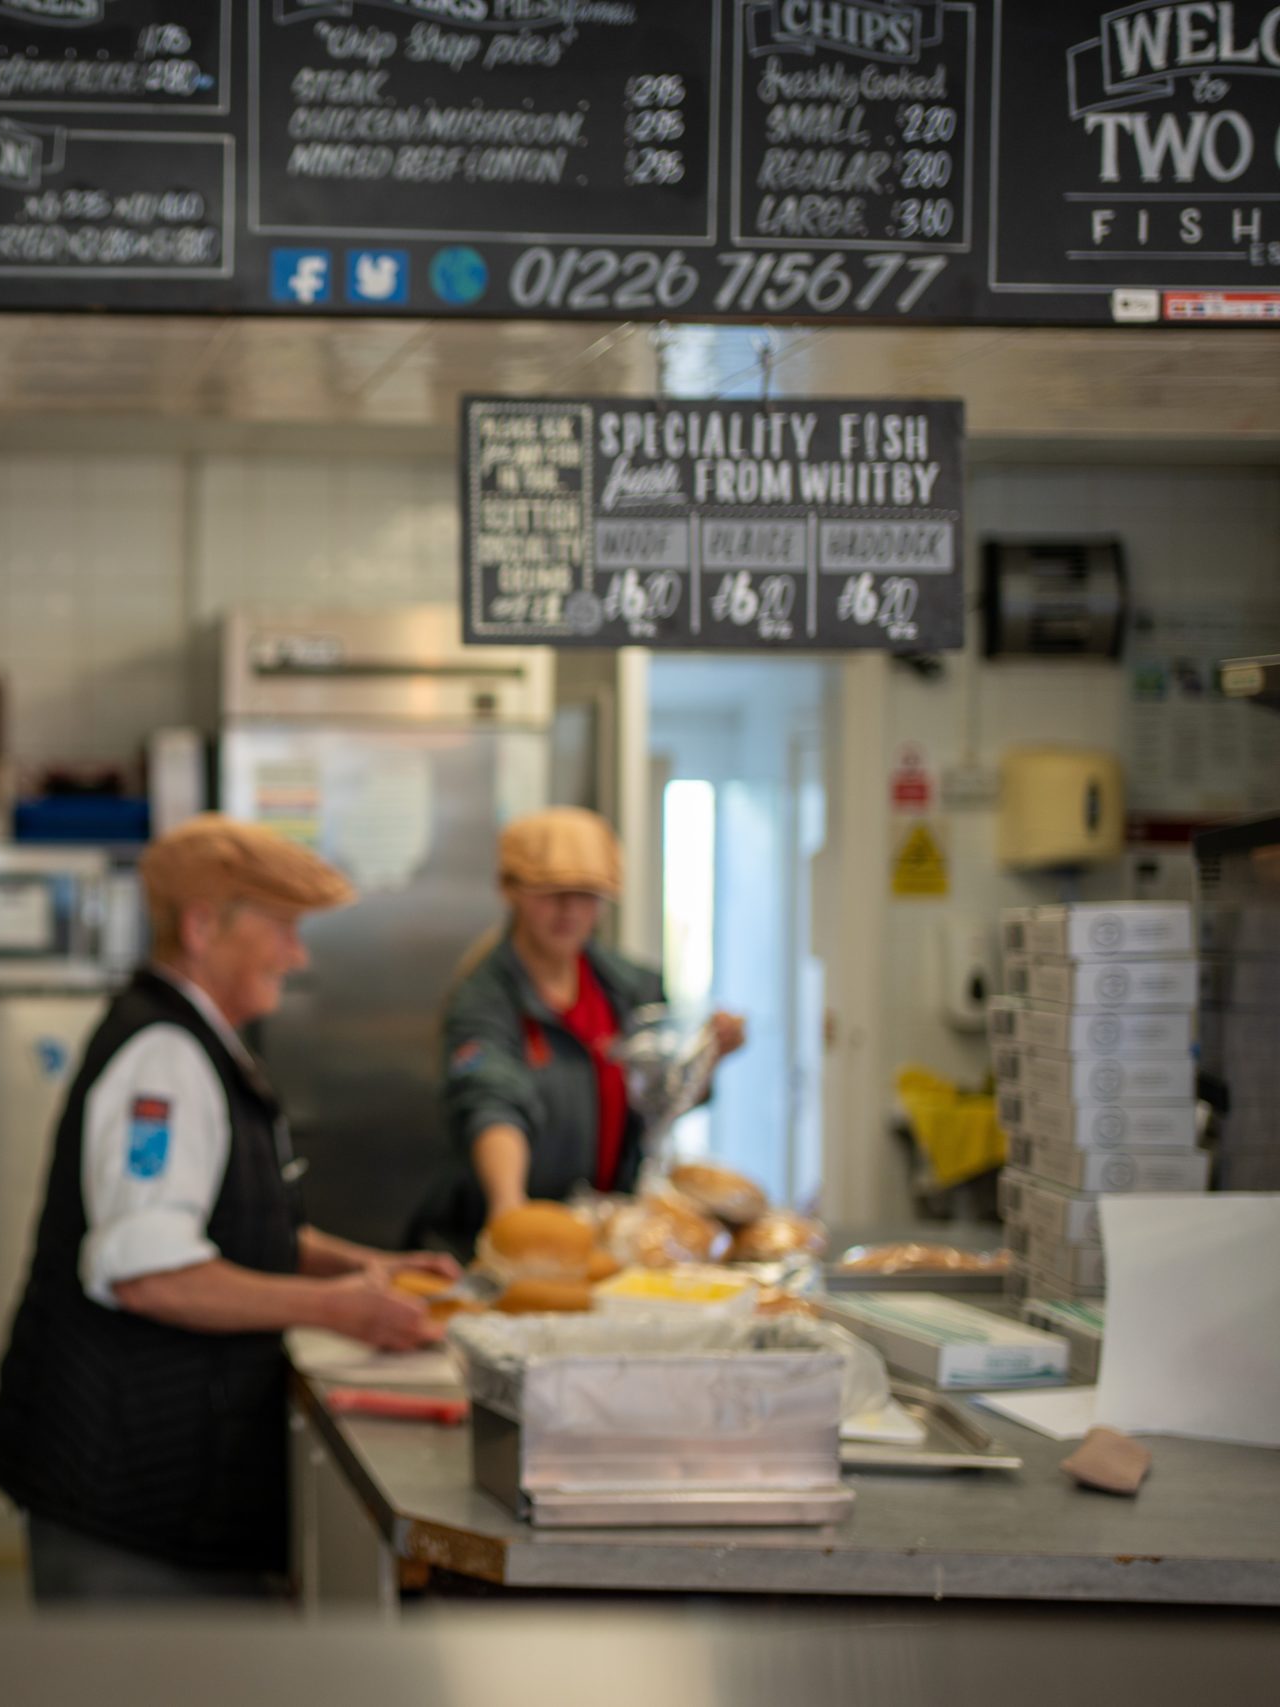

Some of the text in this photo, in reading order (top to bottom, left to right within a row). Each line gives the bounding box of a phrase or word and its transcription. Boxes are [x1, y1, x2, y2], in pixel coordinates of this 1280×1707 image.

[781, 0, 913, 55] CHIPS
[766, 103, 867, 144] SMALL
[1084, 109, 1255, 184] TWO
[756, 194, 867, 237] LARGE
[508, 246, 700, 313] 01226
[714, 251, 950, 314] 715677
[598, 410, 929, 461] SPECIALITY FISH
[695, 458, 793, 505] FROM
[798, 460, 941, 506] WHITBY
